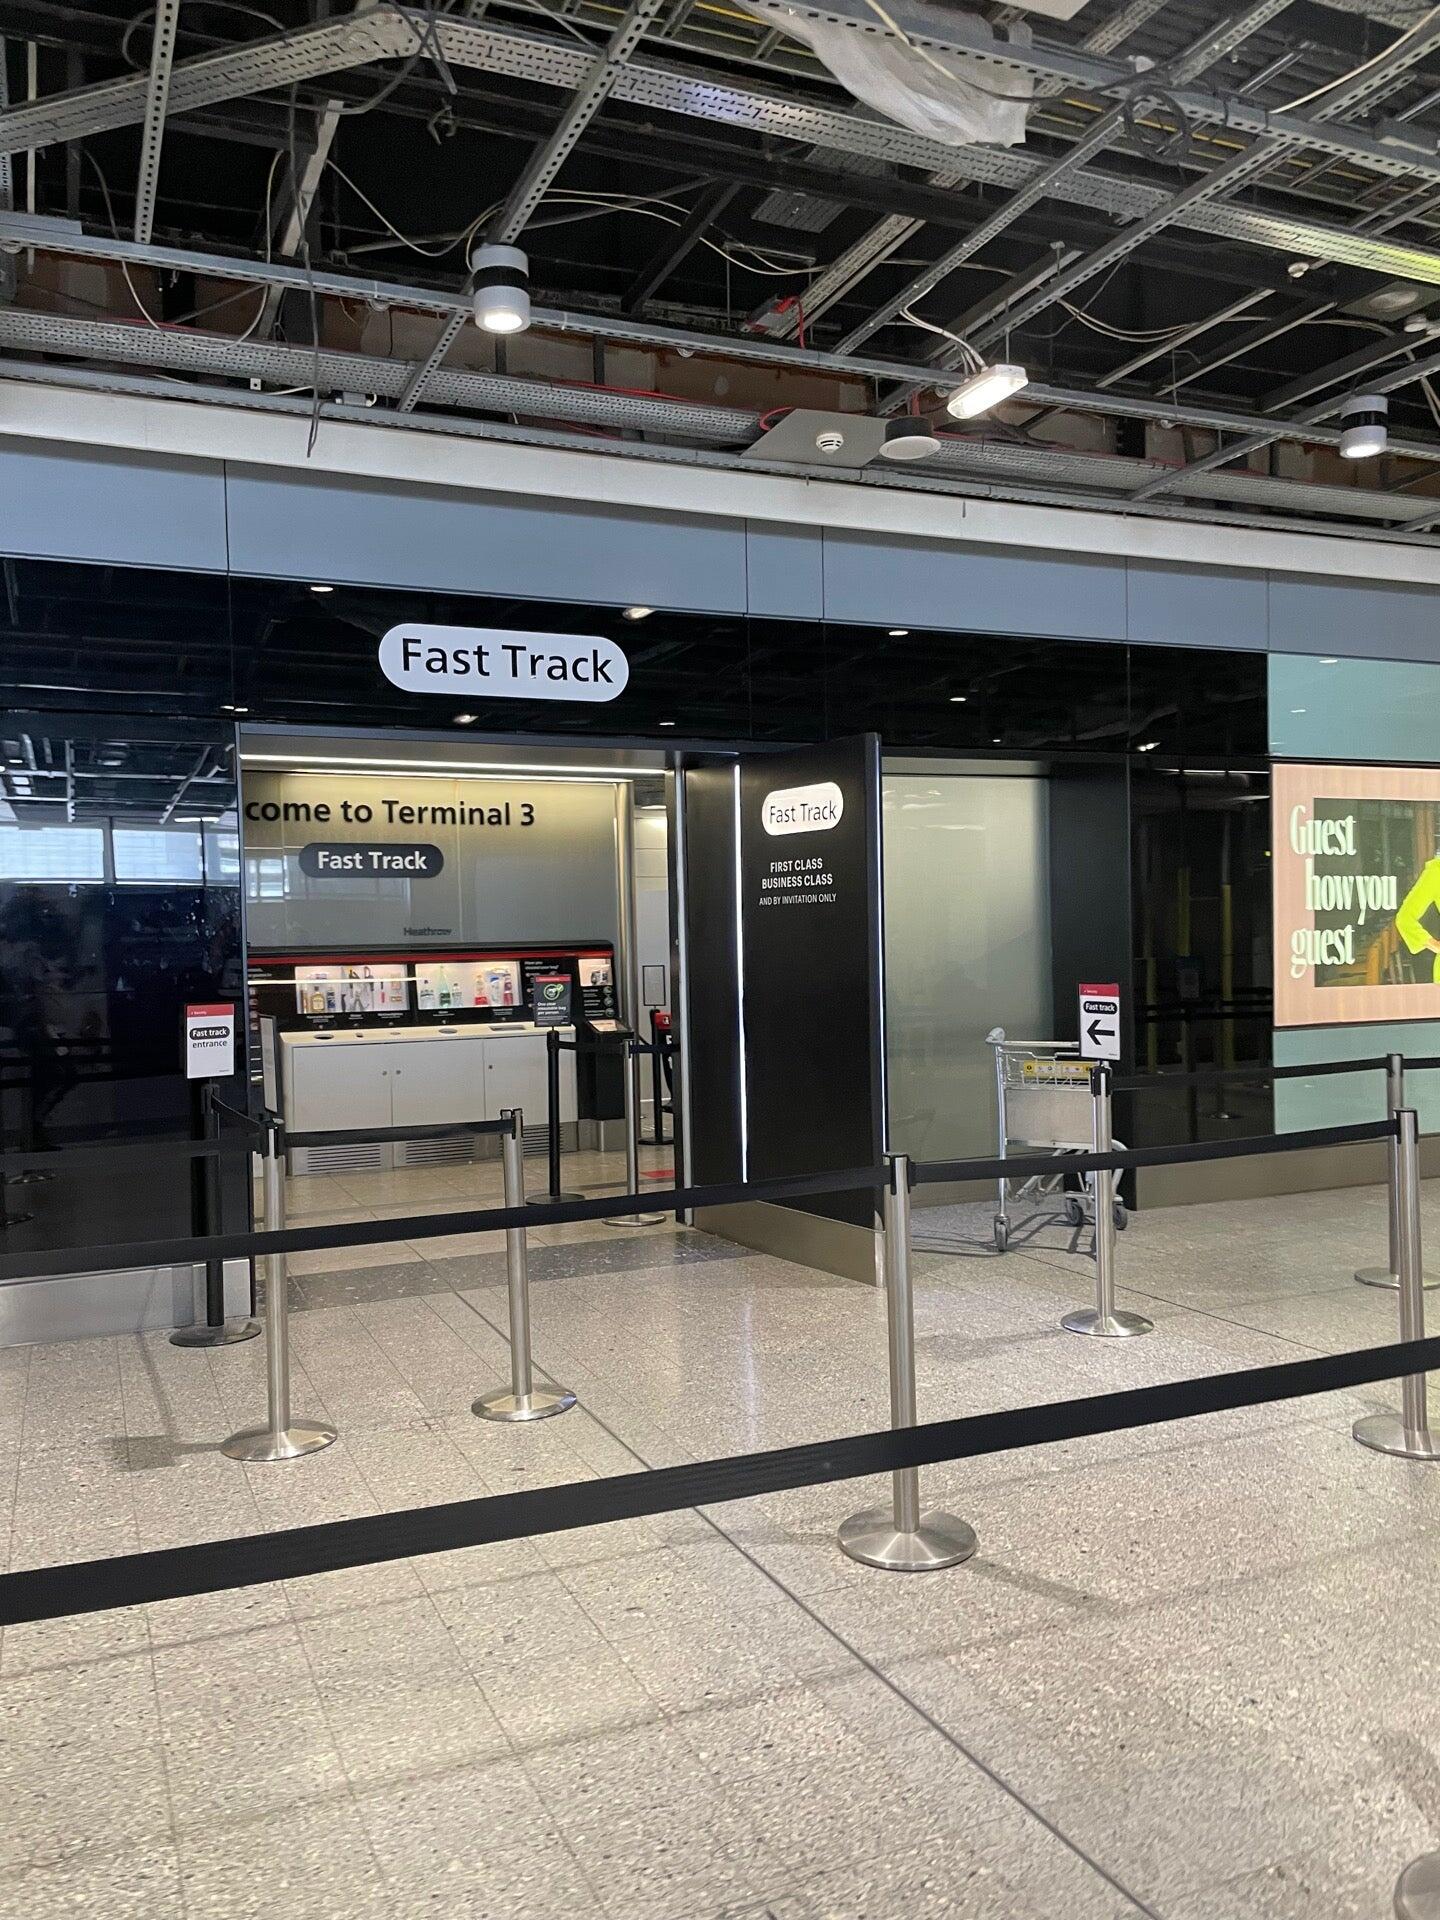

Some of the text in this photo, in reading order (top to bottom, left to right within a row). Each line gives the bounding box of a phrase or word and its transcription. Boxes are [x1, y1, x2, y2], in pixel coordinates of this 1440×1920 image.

[402, 637, 614, 684] Fast Track
[340, 800, 373, 823] to
[381, 799, 511, 826] Terminal
[520, 803, 536, 826] 3
[769, 800, 837, 825] Fast Track
[1290, 804, 1357, 856] Guest
[317, 851, 427, 870] Fast Track
[770, 857, 823, 873] FIRST CLASS
[761, 873, 833, 889] BUSINESS CLASS
[759, 893, 837, 906] AND BY INVITATION ONLY
[1305, 858, 1398, 926] how you
[1290, 924, 1356, 979] guest
[1085, 1002, 1115, 1012] Fast track
[192, 1028, 227, 1037] Fast track
[192, 1040, 228, 1048] entrance
